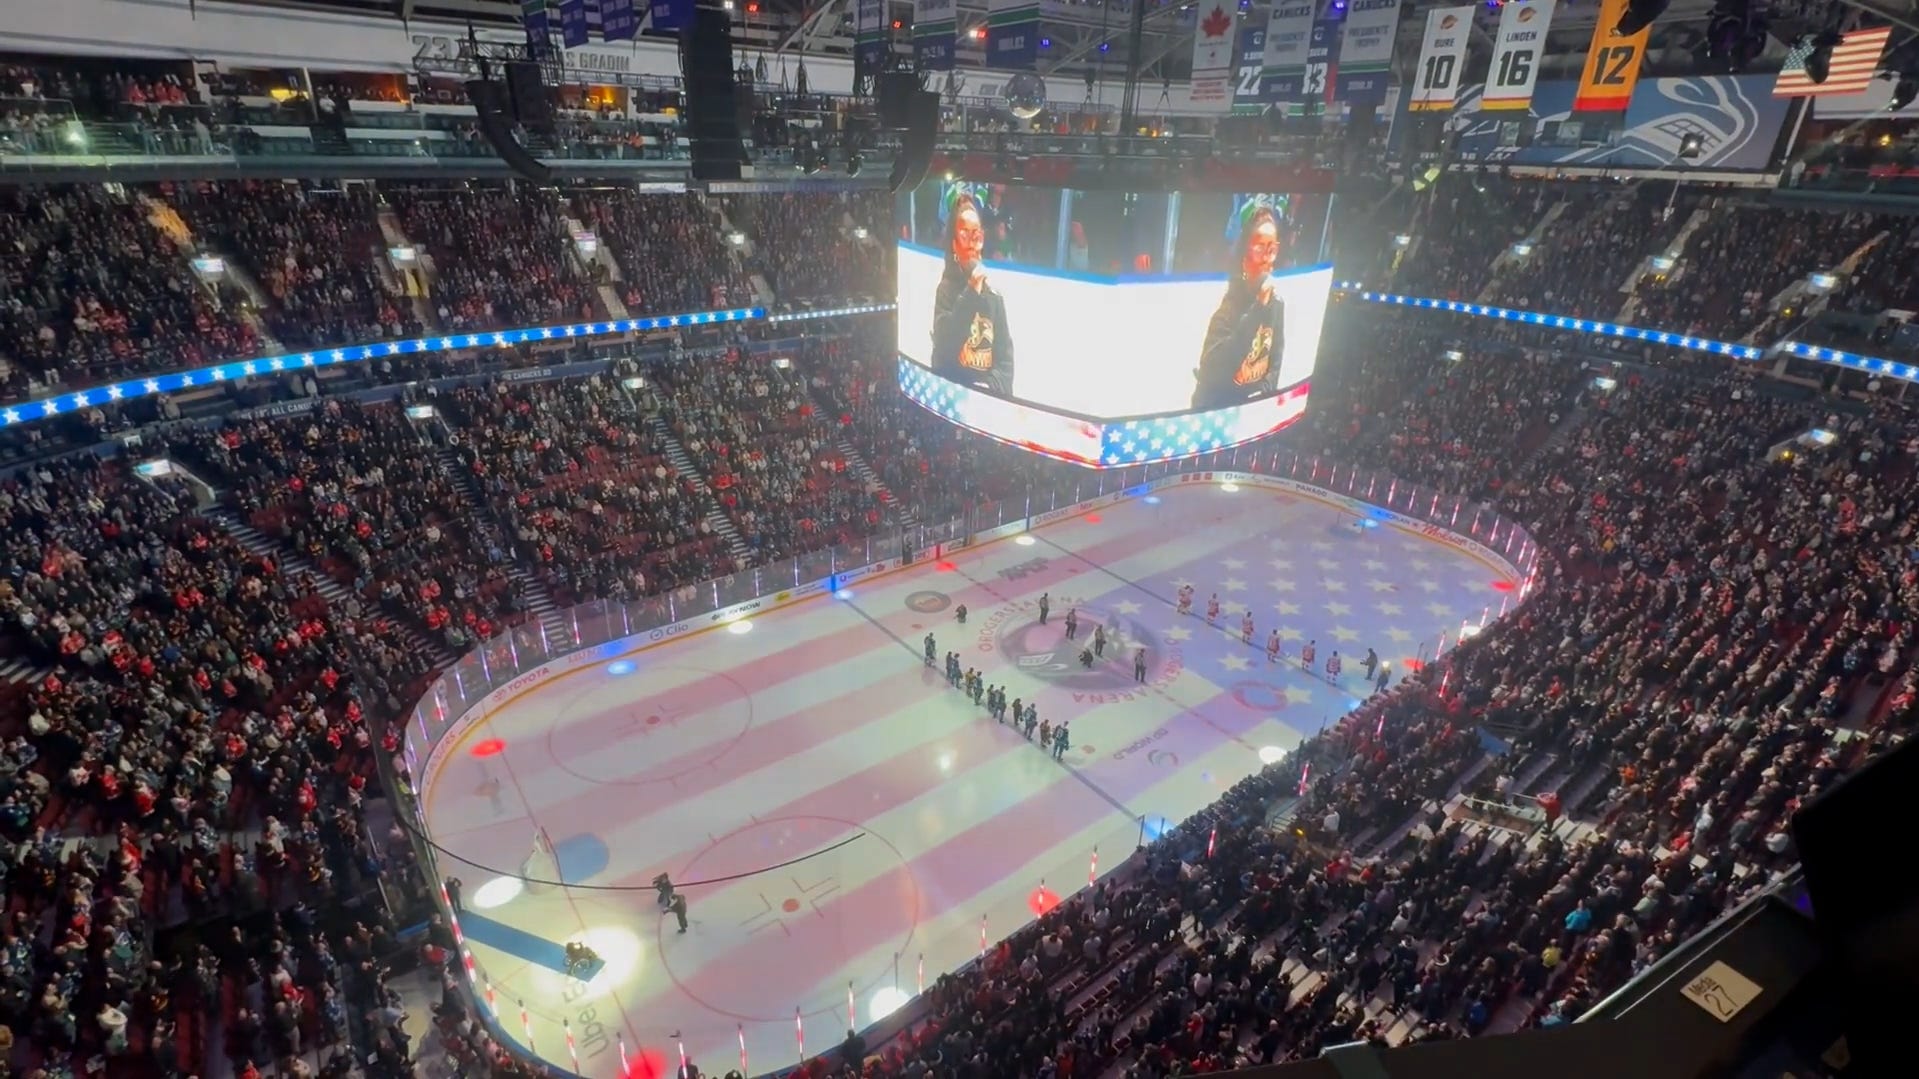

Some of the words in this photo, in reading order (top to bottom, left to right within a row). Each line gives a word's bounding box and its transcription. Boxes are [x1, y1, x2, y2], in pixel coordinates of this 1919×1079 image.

[1273, 5, 1311, 19] CANUCKS
[1434, 38, 1456, 48] BURE
[1506, 31, 1537, 43] LINDEN
[579, 54, 630, 71] GRADIN
[1423, 54, 1456, 89] 10
[1497, 50, 1533, 86] 16
[1592, 46, 1635, 85] 12
[1237, 66, 1262, 95] 22
[667, 622, 689, 635] Clio
[508, 667, 550, 691] TOYOTA
[1704, 985, 1738, 1017] 27
